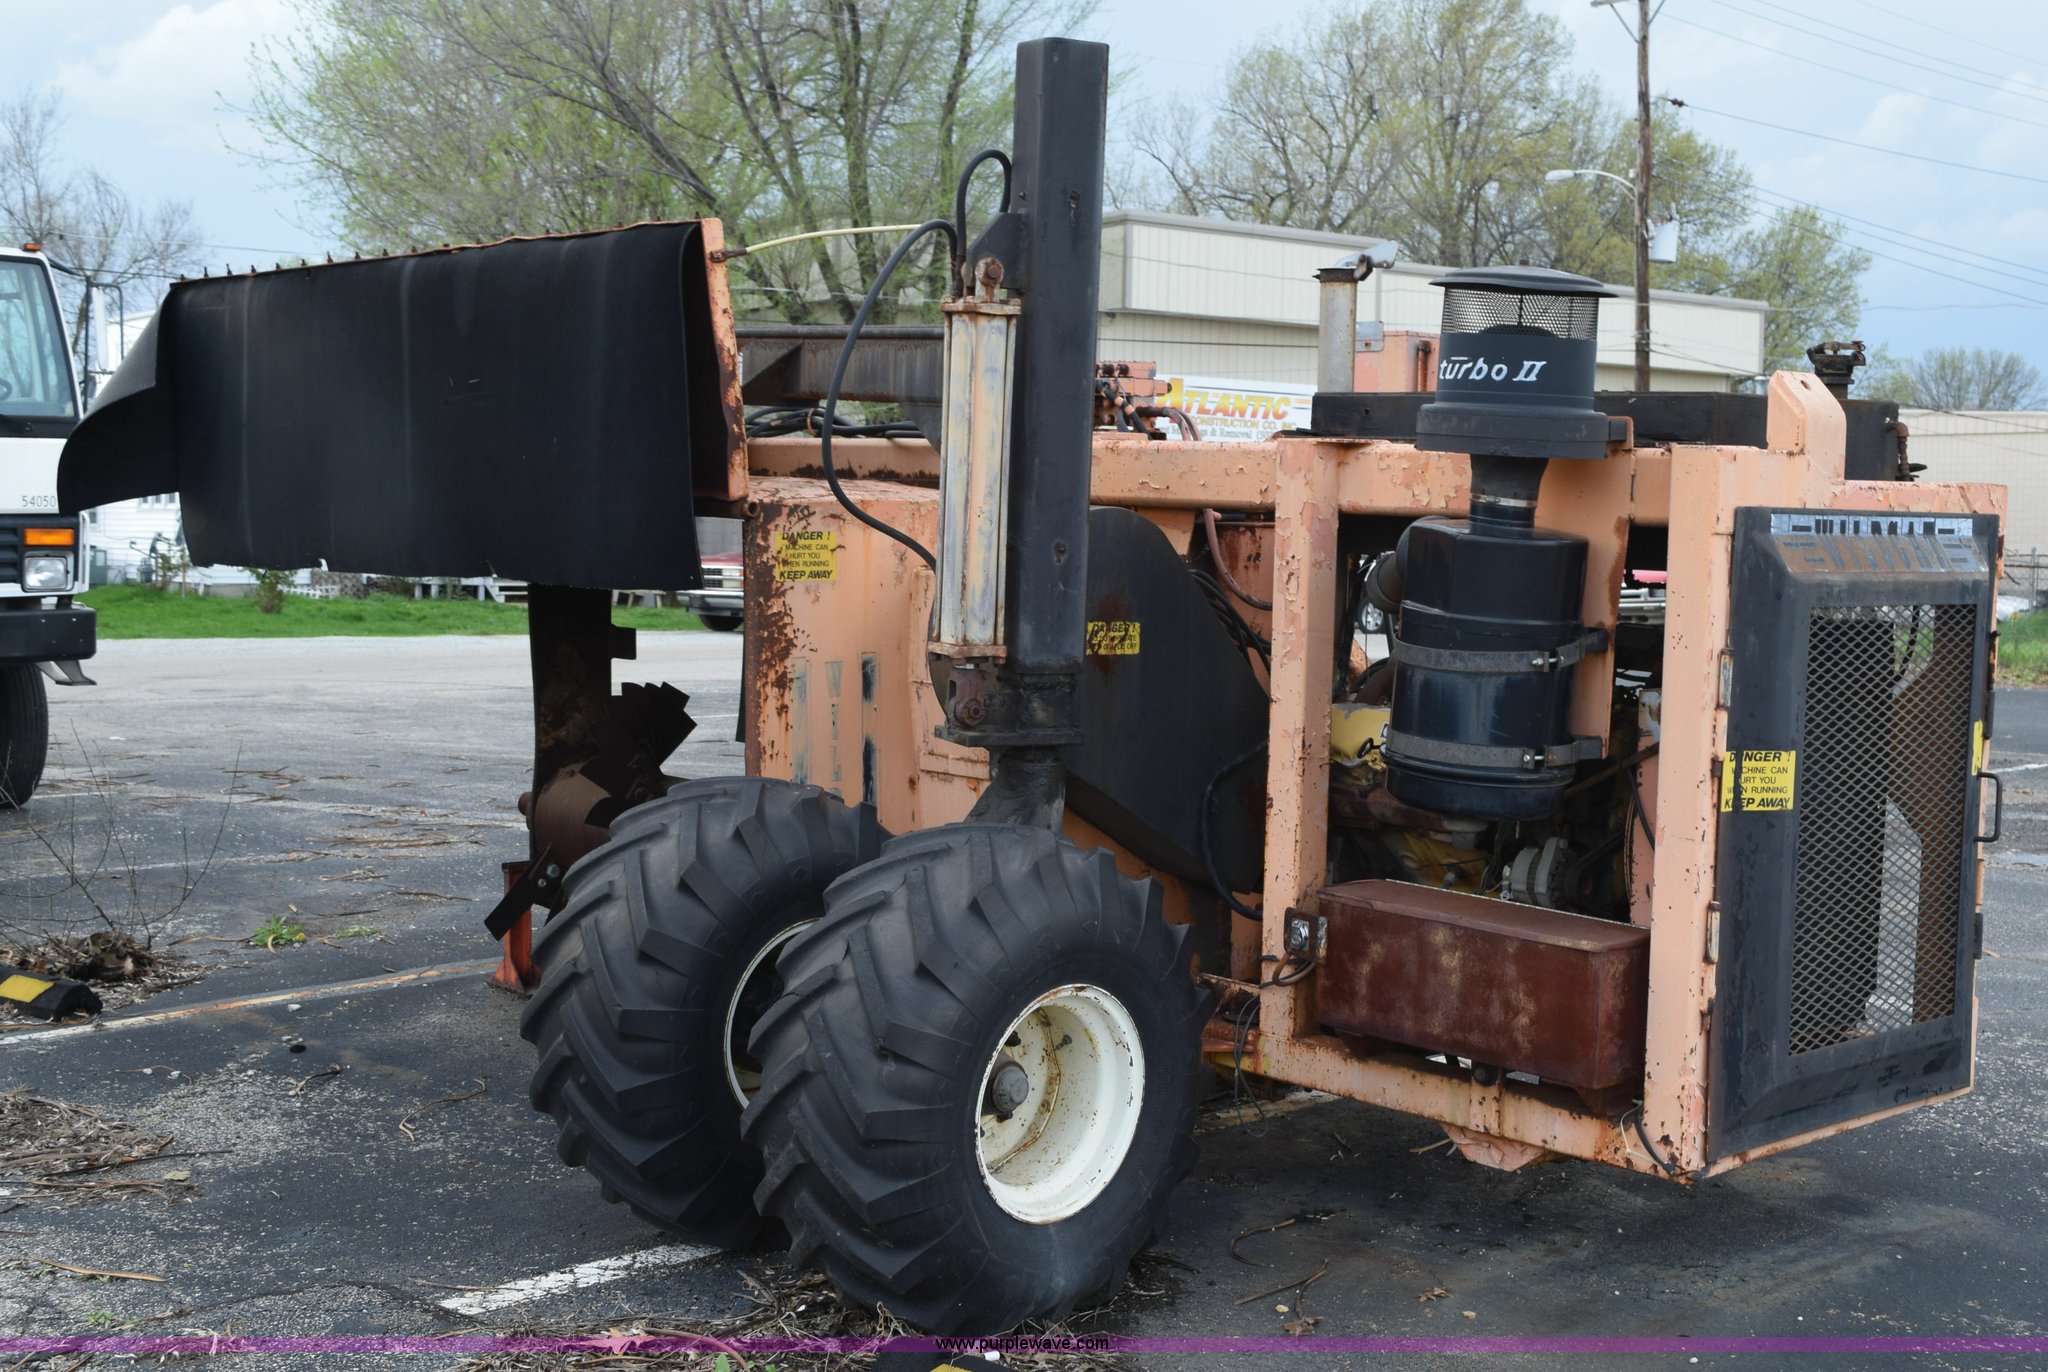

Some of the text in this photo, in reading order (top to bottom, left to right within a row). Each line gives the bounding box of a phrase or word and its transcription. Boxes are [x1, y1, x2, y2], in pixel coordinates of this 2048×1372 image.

[1156, 378, 1291, 420] ATLANTIC
[21, 495, 57, 508] 54050
[782, 531, 823, 540] DANGER
[780, 570, 832, 579] KEEP AWAY
[1729, 751, 1782, 762] DNGER
[1738, 776, 1776, 784] URT YOU
[1751, 786, 1788, 794] RUNNING
[1724, 797, 1790, 809] KEP AWAY
